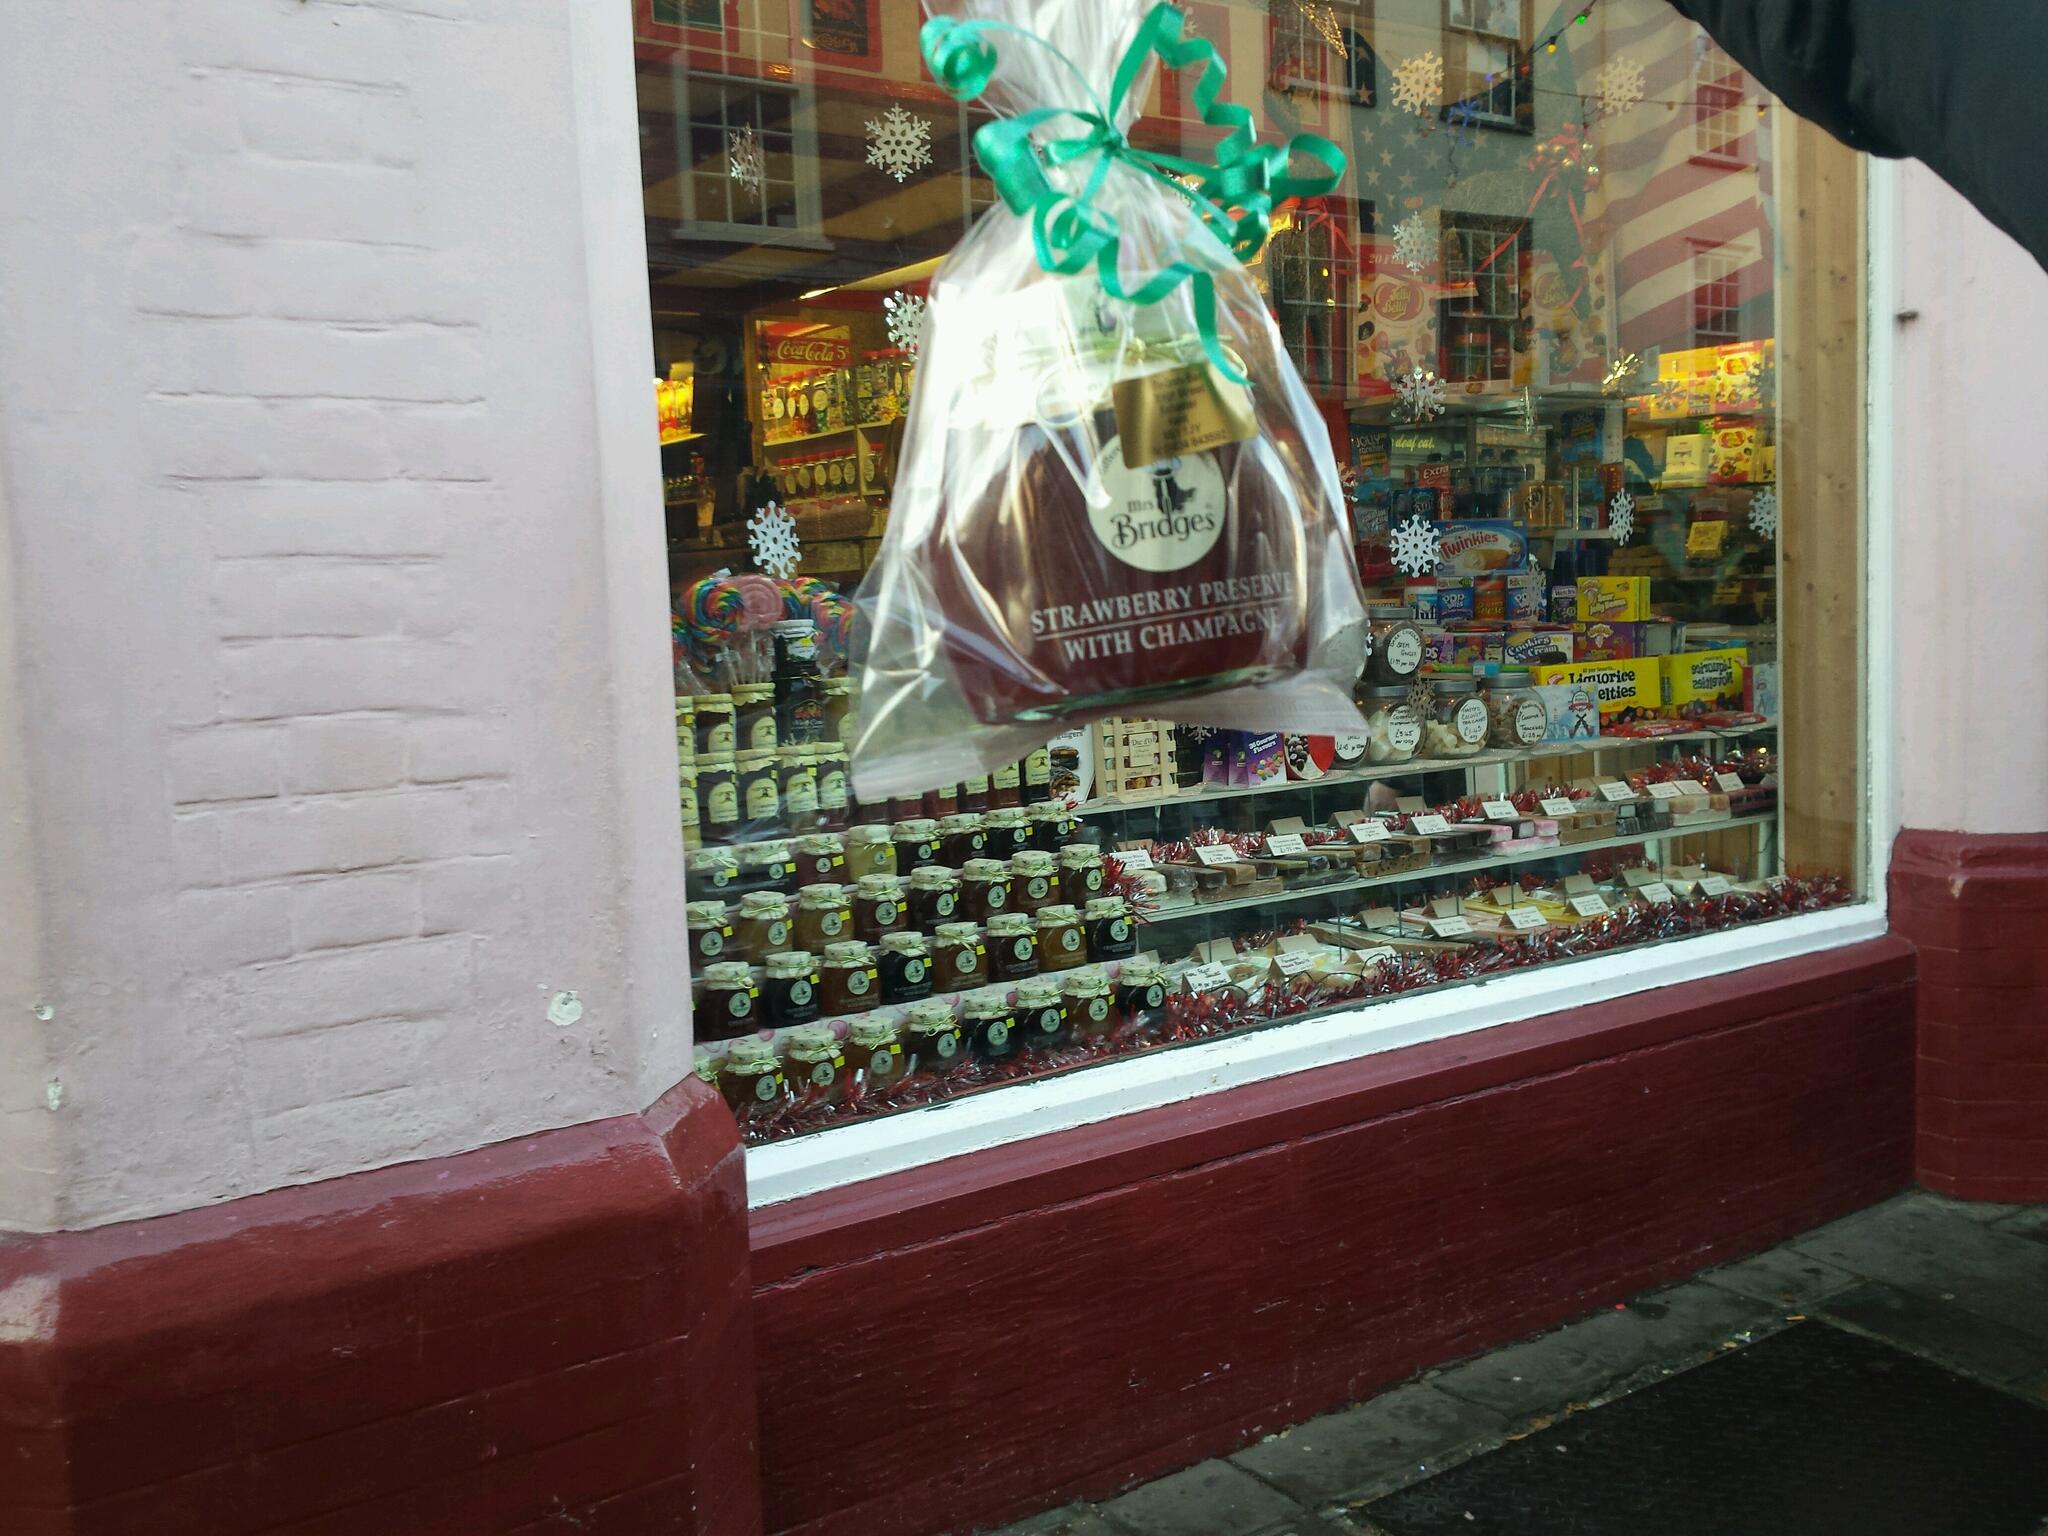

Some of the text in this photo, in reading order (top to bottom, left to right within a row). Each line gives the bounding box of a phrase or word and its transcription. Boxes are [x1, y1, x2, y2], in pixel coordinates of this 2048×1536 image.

[1110, 512, 1216, 550] Bridges
[1440, 531, 1500, 560] Twinkies
[1030, 585, 1194, 635] STRAWBERRY
[1064, 605, 1284, 662] WITH CHAMPAGNE
[1507, 636, 1551, 657] Cookies
[1597, 685, 1637, 701] elties
